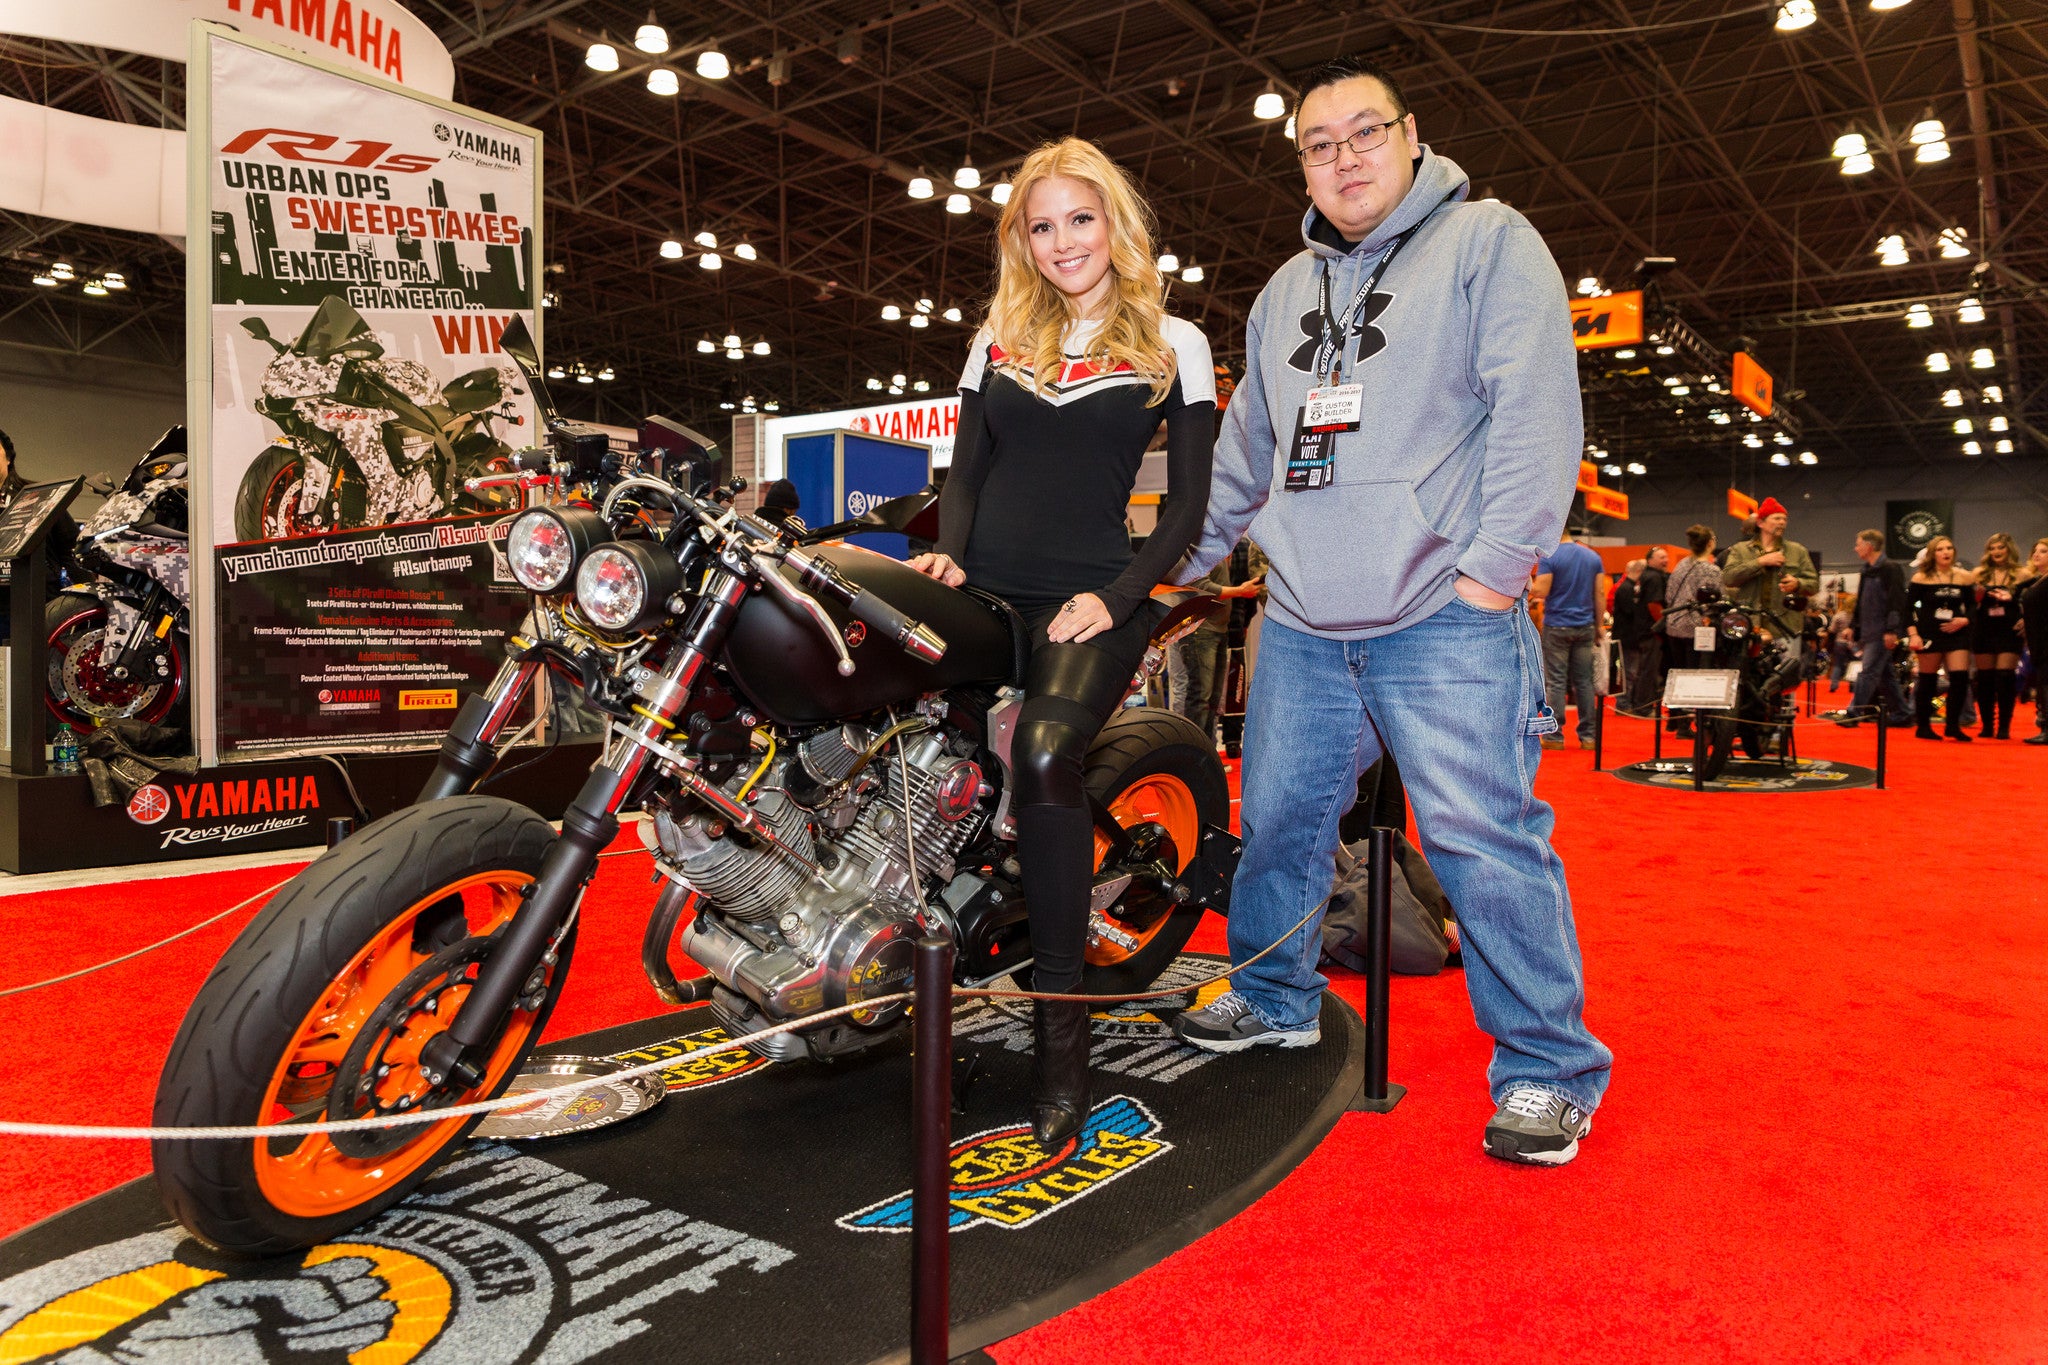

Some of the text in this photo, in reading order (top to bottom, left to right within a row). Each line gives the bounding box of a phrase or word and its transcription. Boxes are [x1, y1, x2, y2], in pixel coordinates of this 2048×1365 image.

[228, 0, 403, 84] AMAHA
[453, 127, 522, 166] YAMAHA
[448, 149, 475, 161] Revs
[475, 158, 494, 167] Your
[222, 160, 391, 201] URBAN OPS
[286, 197, 521, 244] SWEEPSTAKES
[272, 250, 433, 282] ENTER FOR A
[348, 287, 434, 309] CHANCE
[1325, 401, 1353, 410] CUSTOM
[1324, 409, 1352, 417] BUILDER
[876, 404, 959, 439] YAMAH
[1301, 445, 1319, 459] VOTE
[392, 553, 473, 578] #R1surbanops
[334, 587, 351, 598] Sets
[362, 588, 384, 598] Pirelli
[311, 600, 322, 608] sets
[329, 600, 345, 608] Pirelli
[370, 601, 382, 609] tires
[412, 602, 437, 610] whichever
[318, 614, 348, 625] Yamaha
[349, 615, 379, 625] Genuine
[381, 616, 402, 626] Parts
[254, 627, 272, 635] Frame
[273, 627, 292, 635] Sliders
[297, 627, 325, 635] Endurance
[326, 628, 356, 636] Windscreen
[369, 628, 395, 636] Eliminator
[286, 637, 306, 647] Folding
[441, 638, 456, 647] Swing
[358, 652, 395, 661] Additional
[325, 664, 344, 672] Graves
[345, 664, 377, 673] Motorsports
[423, 663, 436, 672] Body
[436, 664, 449, 672] Wrap
[301, 674, 322, 682] Powder
[323, 674, 342, 682] Coated
[334, 689, 380, 702] YAMAHA
[404, 693, 452, 706] PIRELLI
[174, 775, 320, 820] YAMAHA
[160, 815, 309, 849] Revs Your Heart
[949, 1130, 1161, 1225] CYCLES
